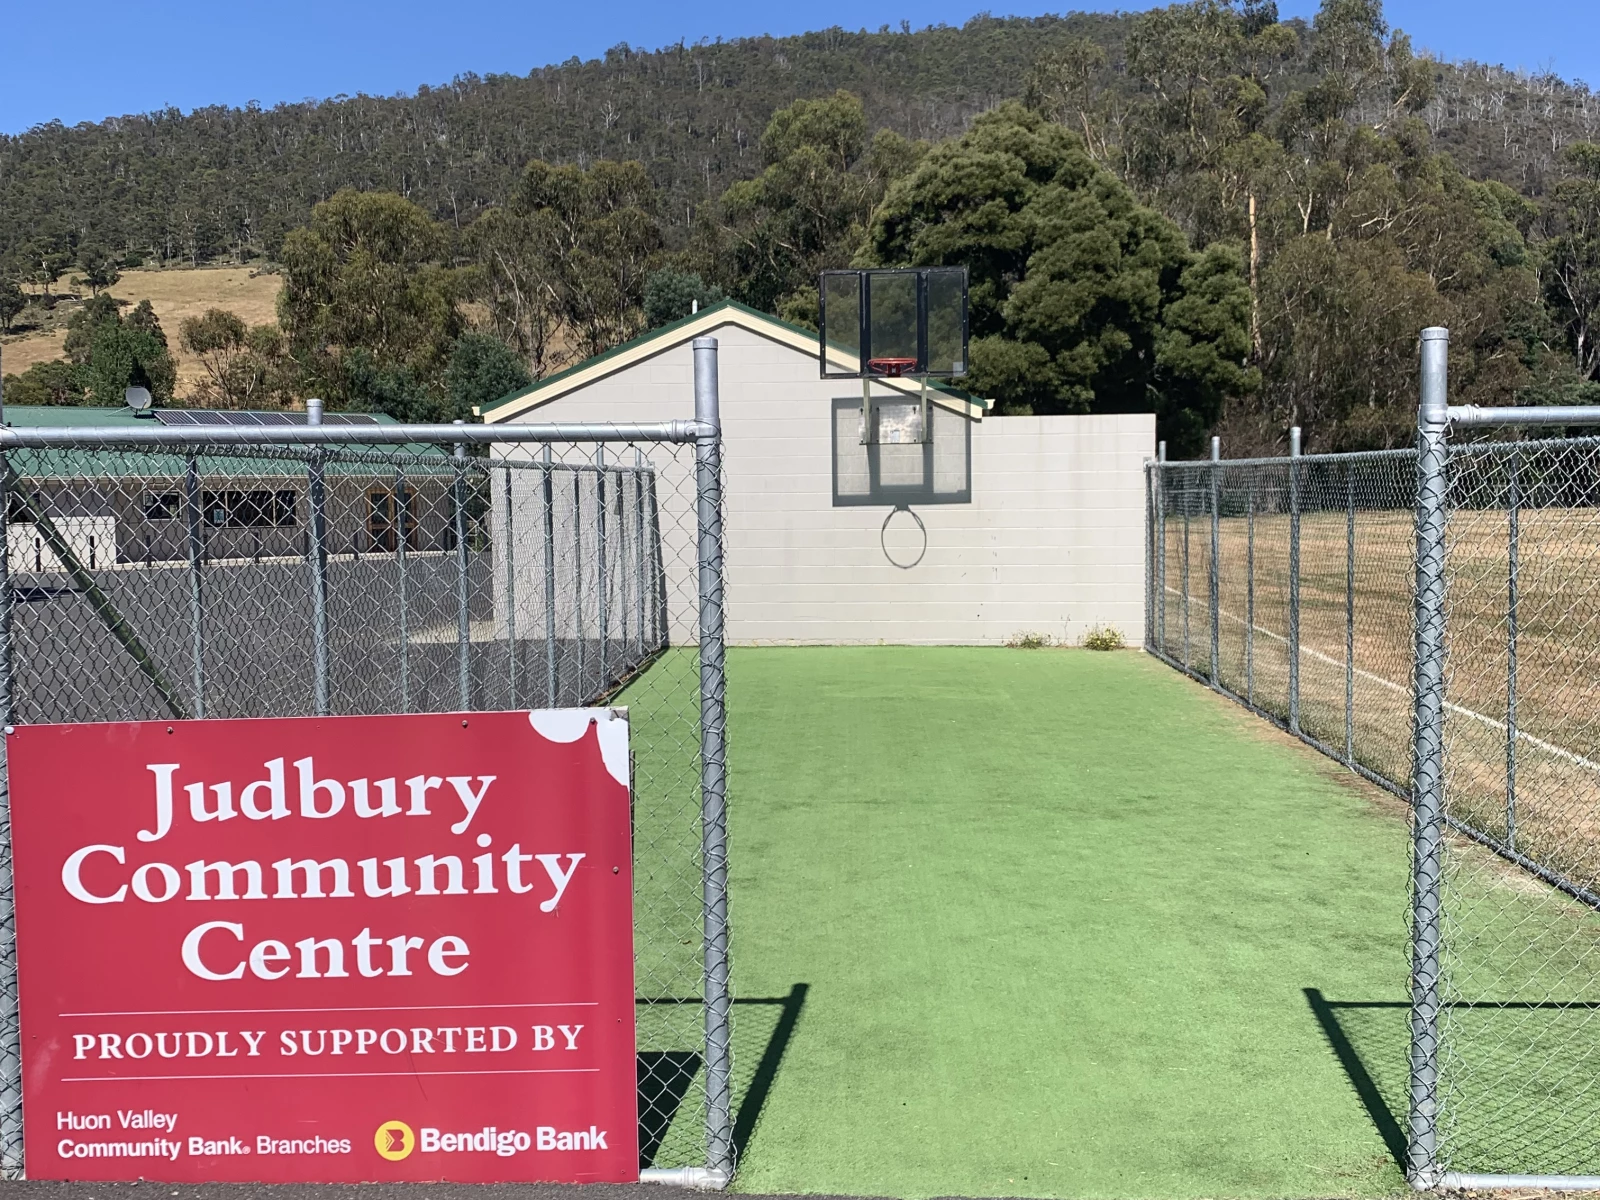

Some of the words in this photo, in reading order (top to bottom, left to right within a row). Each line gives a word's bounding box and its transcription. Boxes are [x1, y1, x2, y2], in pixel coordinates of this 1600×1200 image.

[137, 757, 497, 842] Judbury
[61, 834, 586, 912] Community
[182, 921, 470, 980] Centre
[73, 1031, 266, 1059] PROUDLY
[281, 1026, 517, 1055] SUPPORTED
[532, 1025, 584, 1050] BY
[57, 1112, 110, 1129] Huon
[117, 1110, 177, 1132] Valley
[58, 1138, 181, 1160] Community
[257, 1136, 351, 1154] Branches
[421, 1127, 531, 1156] Bendigo
[537, 1126, 608, 1150] Bank
